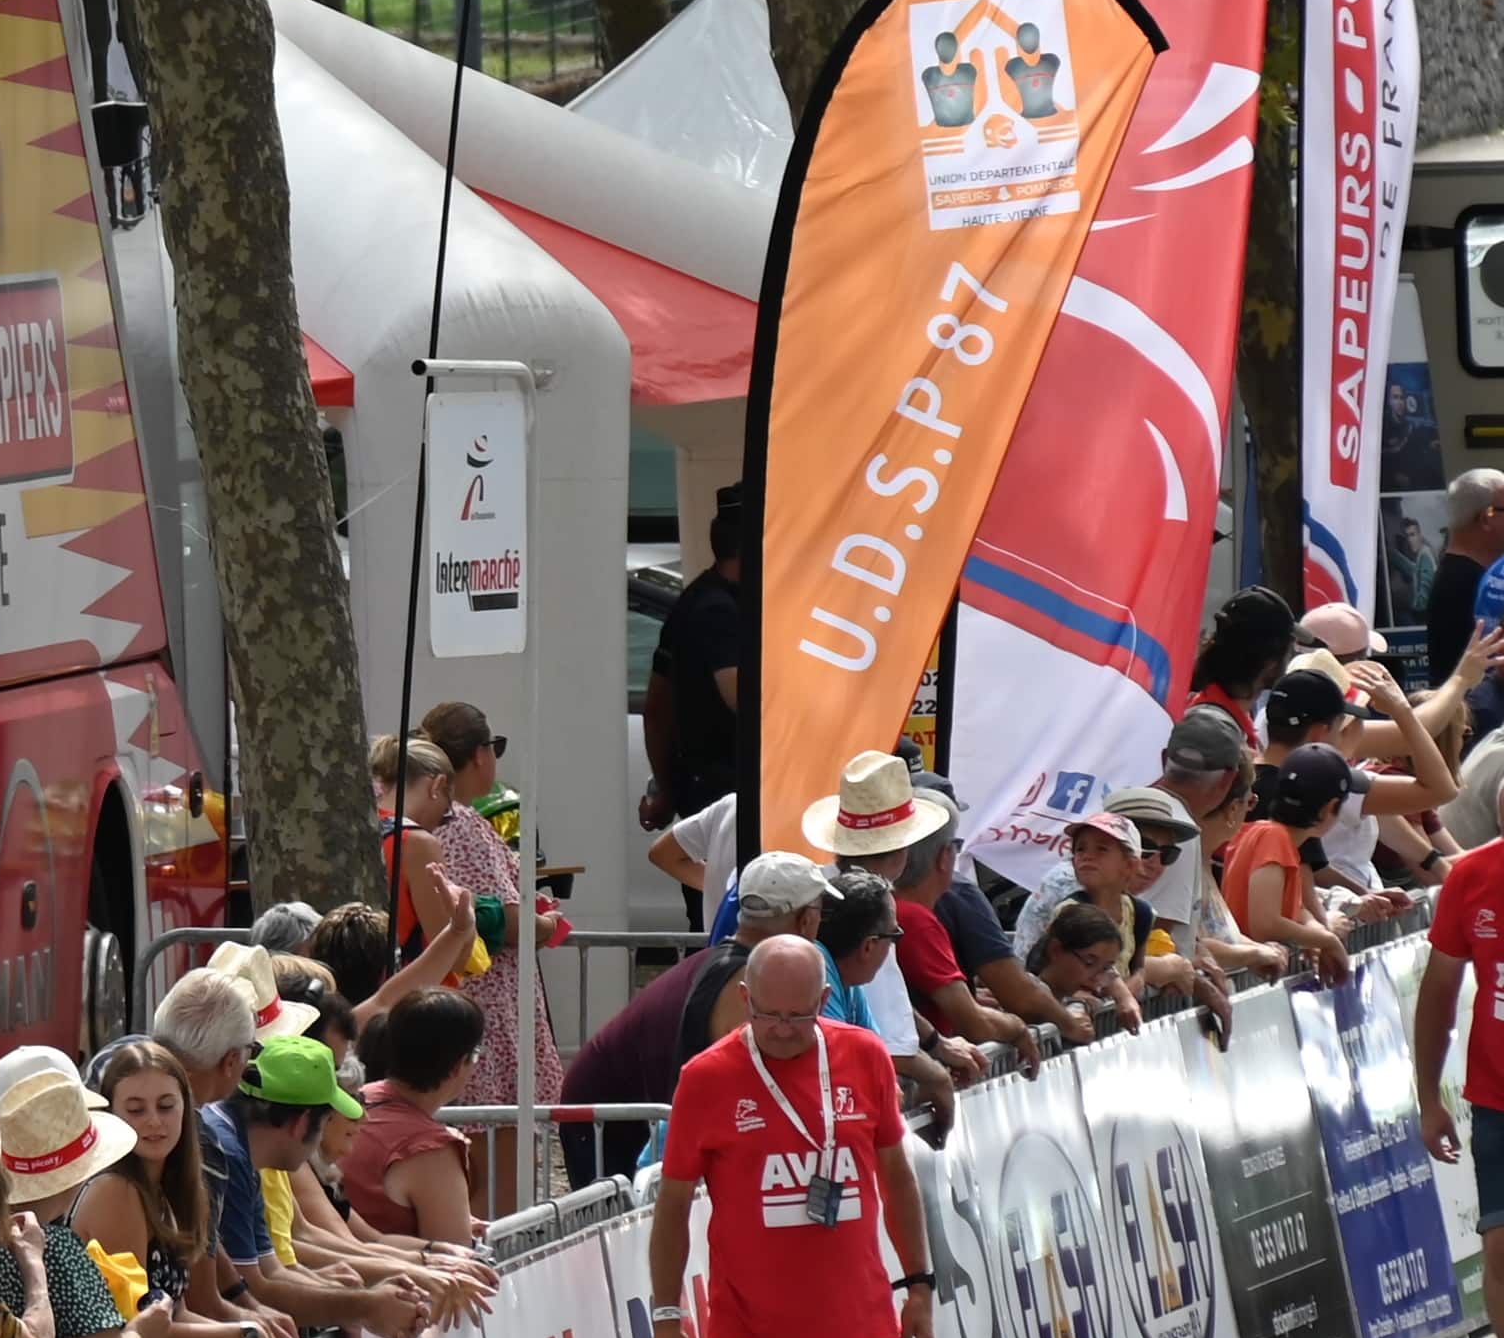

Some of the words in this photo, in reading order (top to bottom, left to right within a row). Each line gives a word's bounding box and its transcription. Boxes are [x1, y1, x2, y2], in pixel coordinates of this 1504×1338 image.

[1337, 135, 1374, 463] SAPEURS
[435, 548, 521, 601] Intermarché
[798, 376, 965, 672] U.D.S.P
[926, 262, 1010, 367] 87
